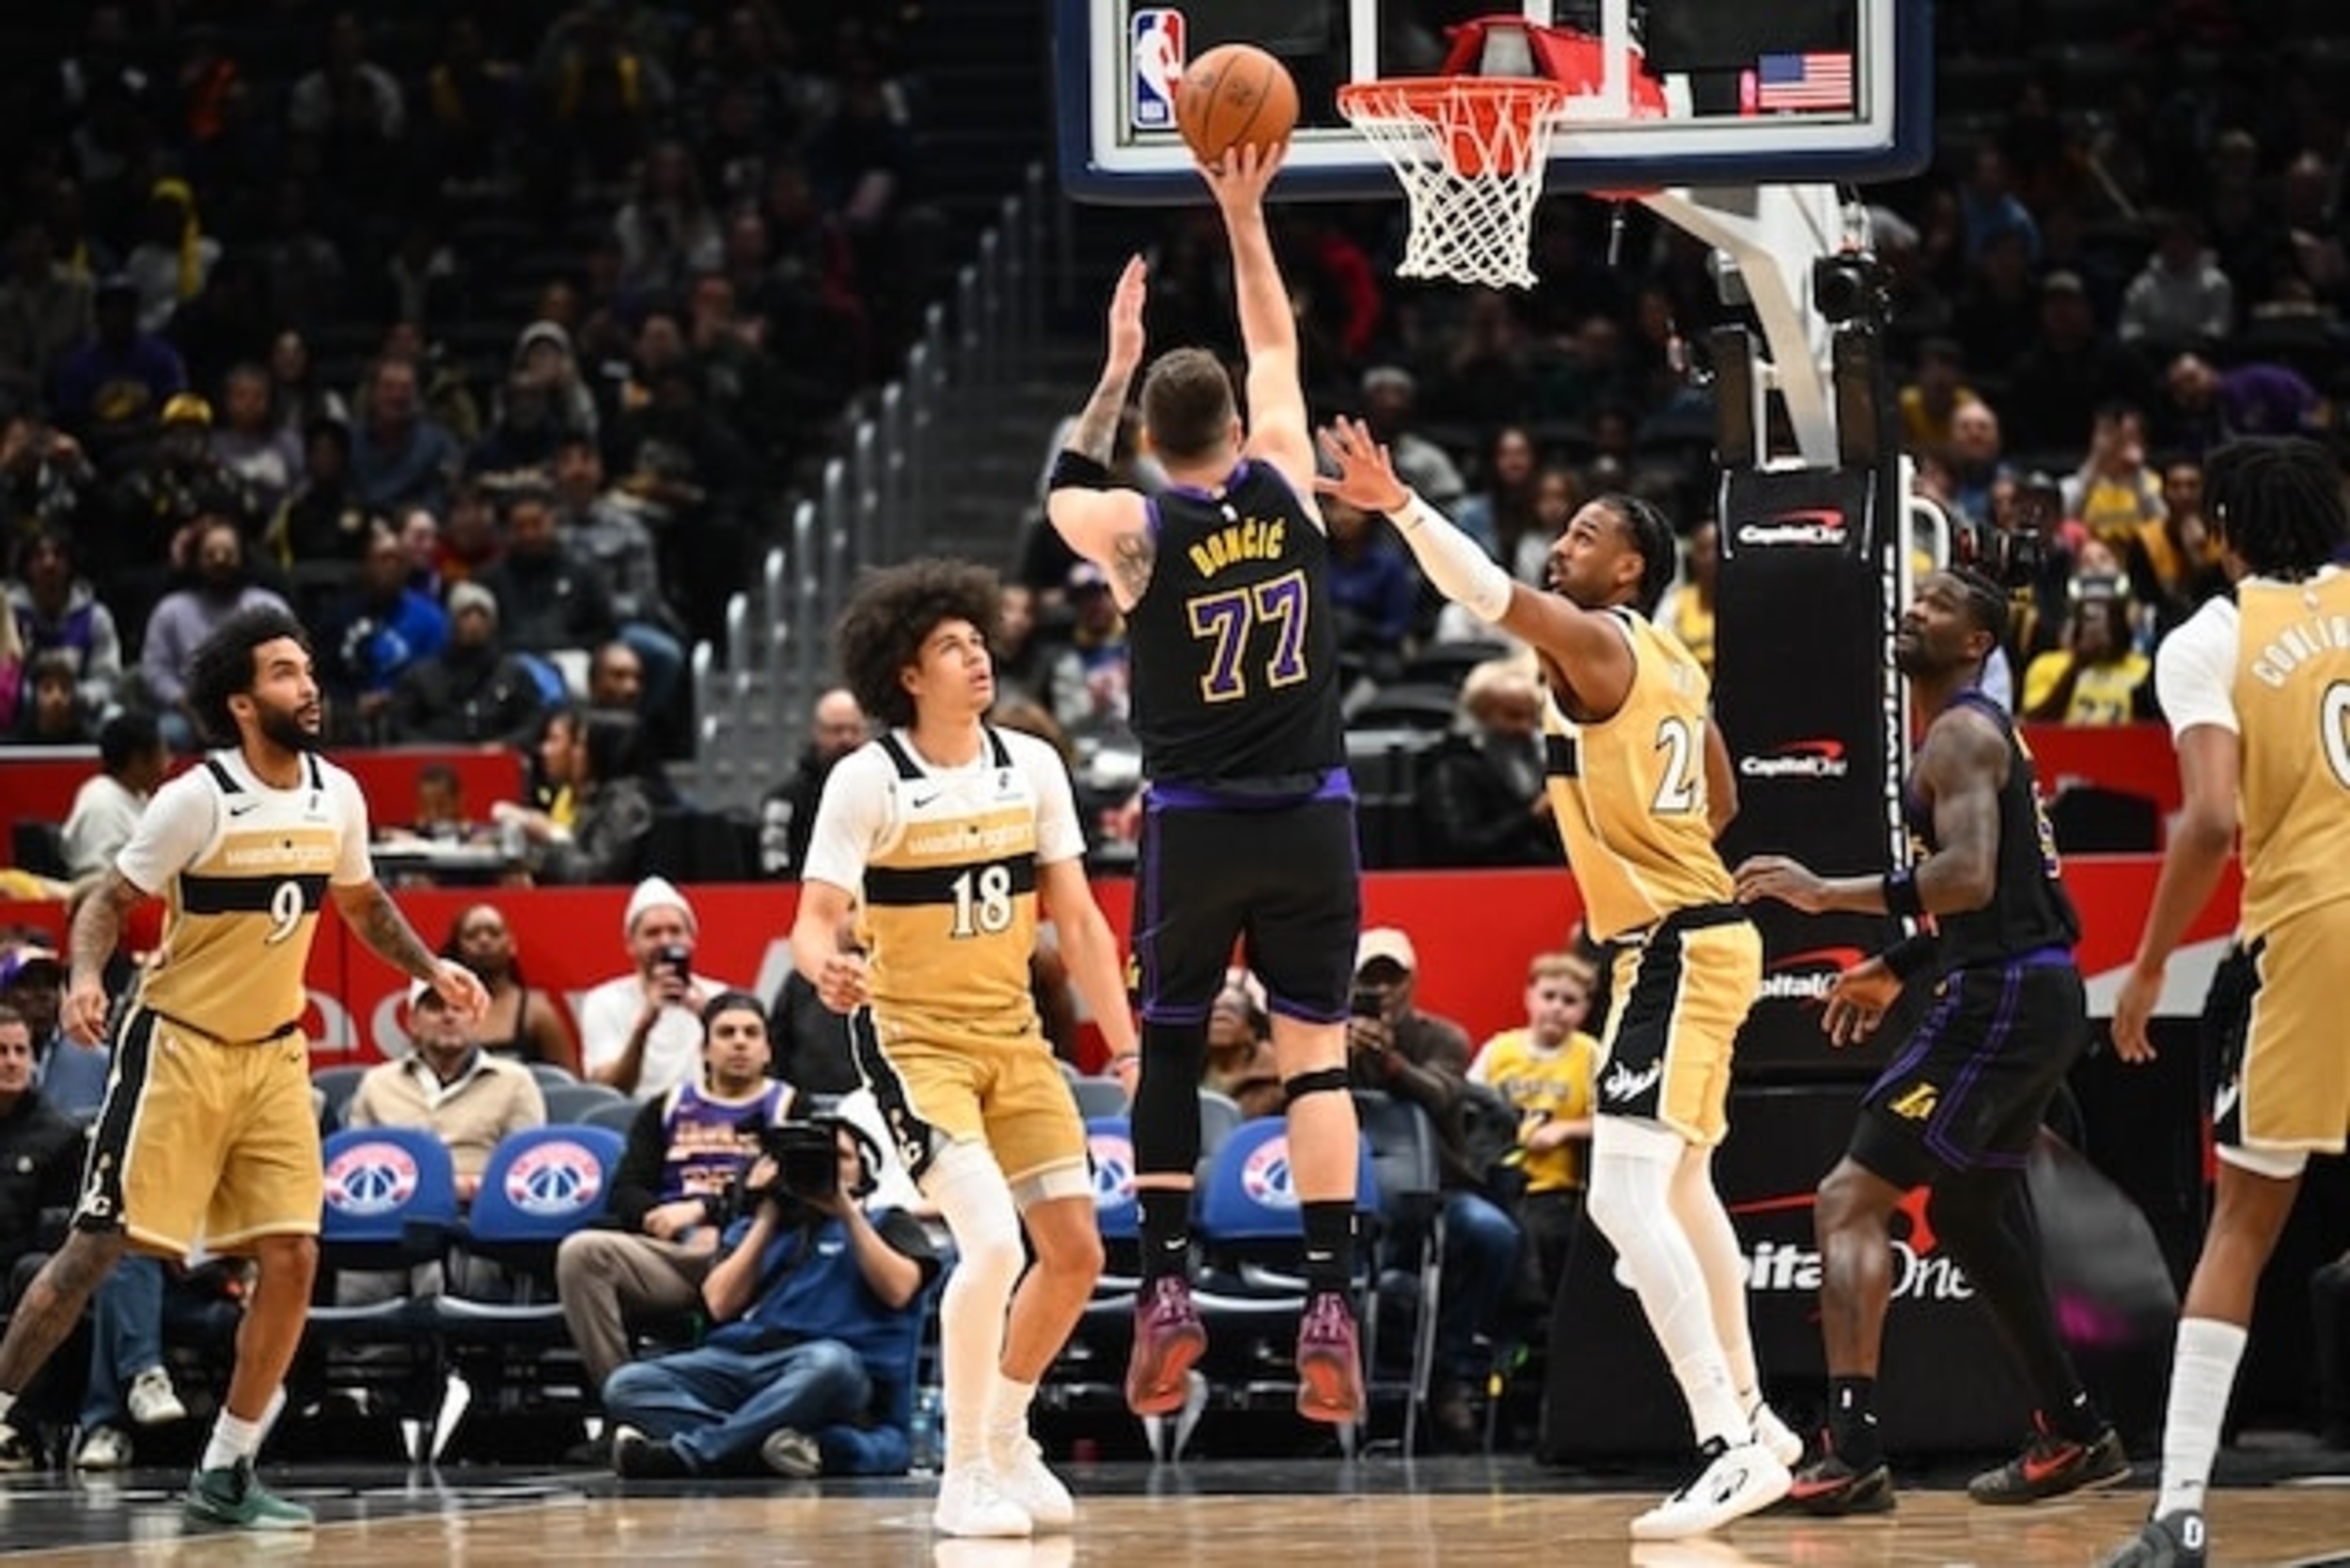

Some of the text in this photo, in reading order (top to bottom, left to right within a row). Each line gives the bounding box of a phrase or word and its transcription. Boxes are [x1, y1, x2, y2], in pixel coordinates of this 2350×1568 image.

[1186, 568, 1308, 703] 77
[265, 880, 304, 946] 9
[949, 863, 1013, 938] 18
[2183, 1515, 2203, 1549] 0
